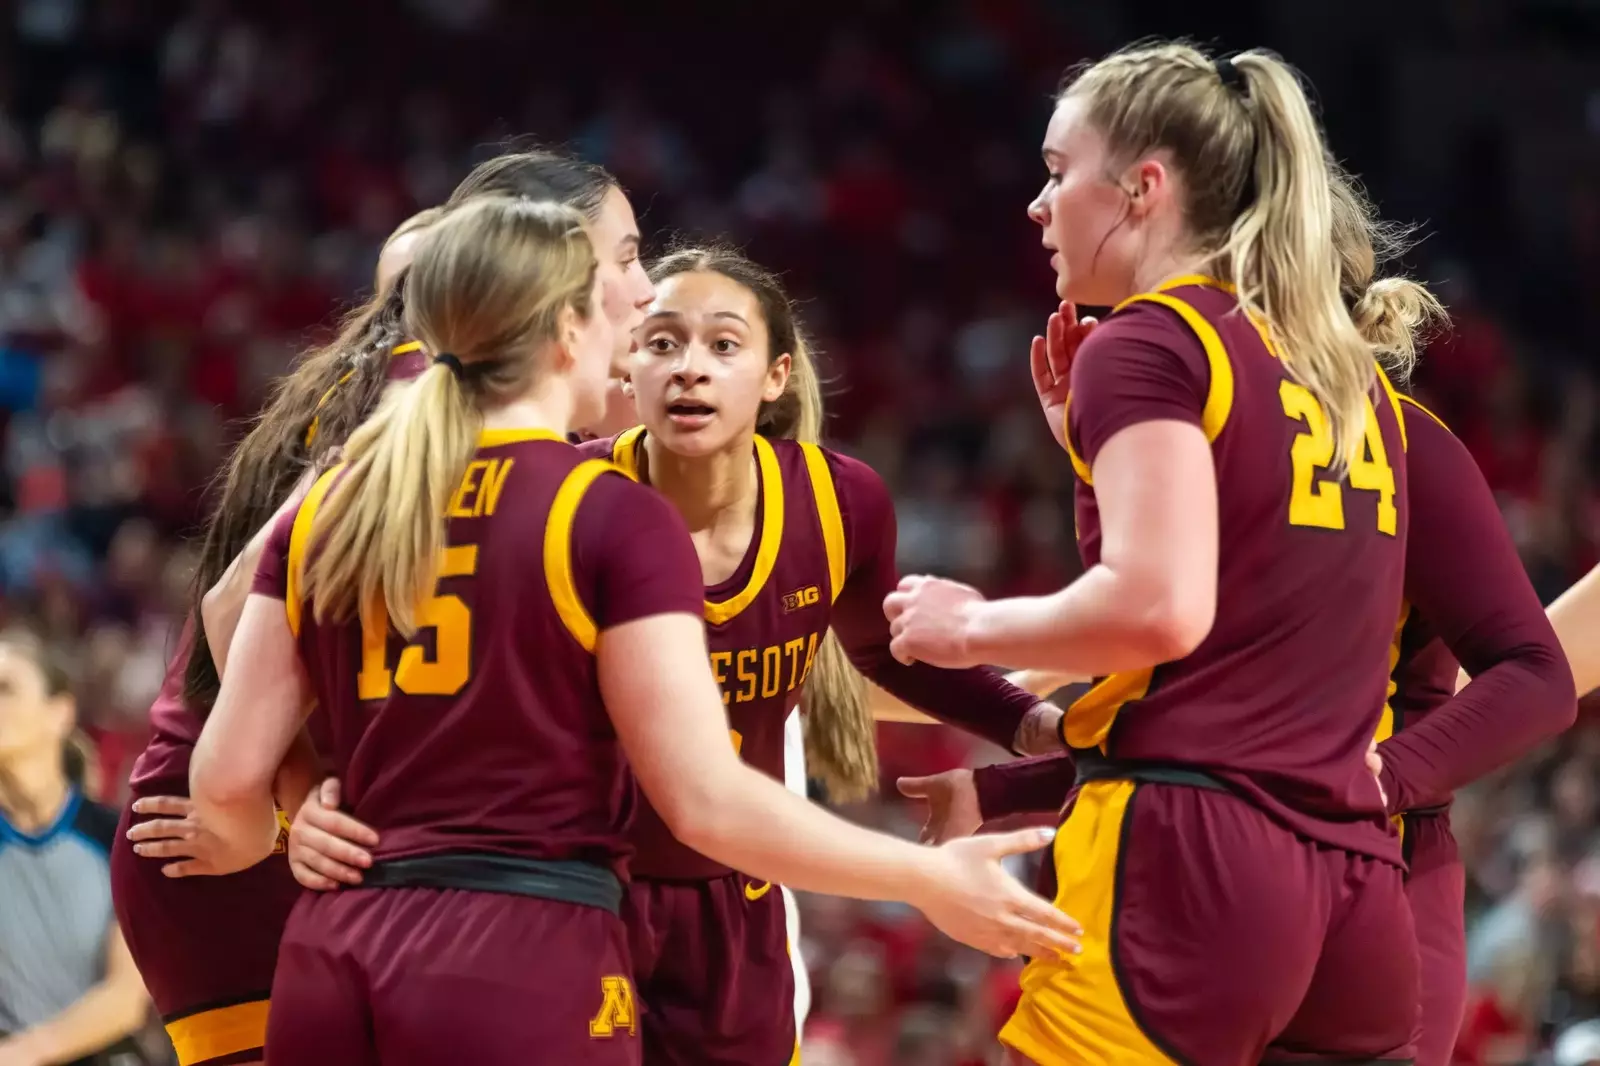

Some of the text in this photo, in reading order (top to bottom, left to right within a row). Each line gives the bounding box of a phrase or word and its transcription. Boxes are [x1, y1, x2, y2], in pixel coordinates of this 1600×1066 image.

[445, 458, 514, 517] EN
[1279, 379, 1397, 536] 24
[358, 544, 478, 700] 15
